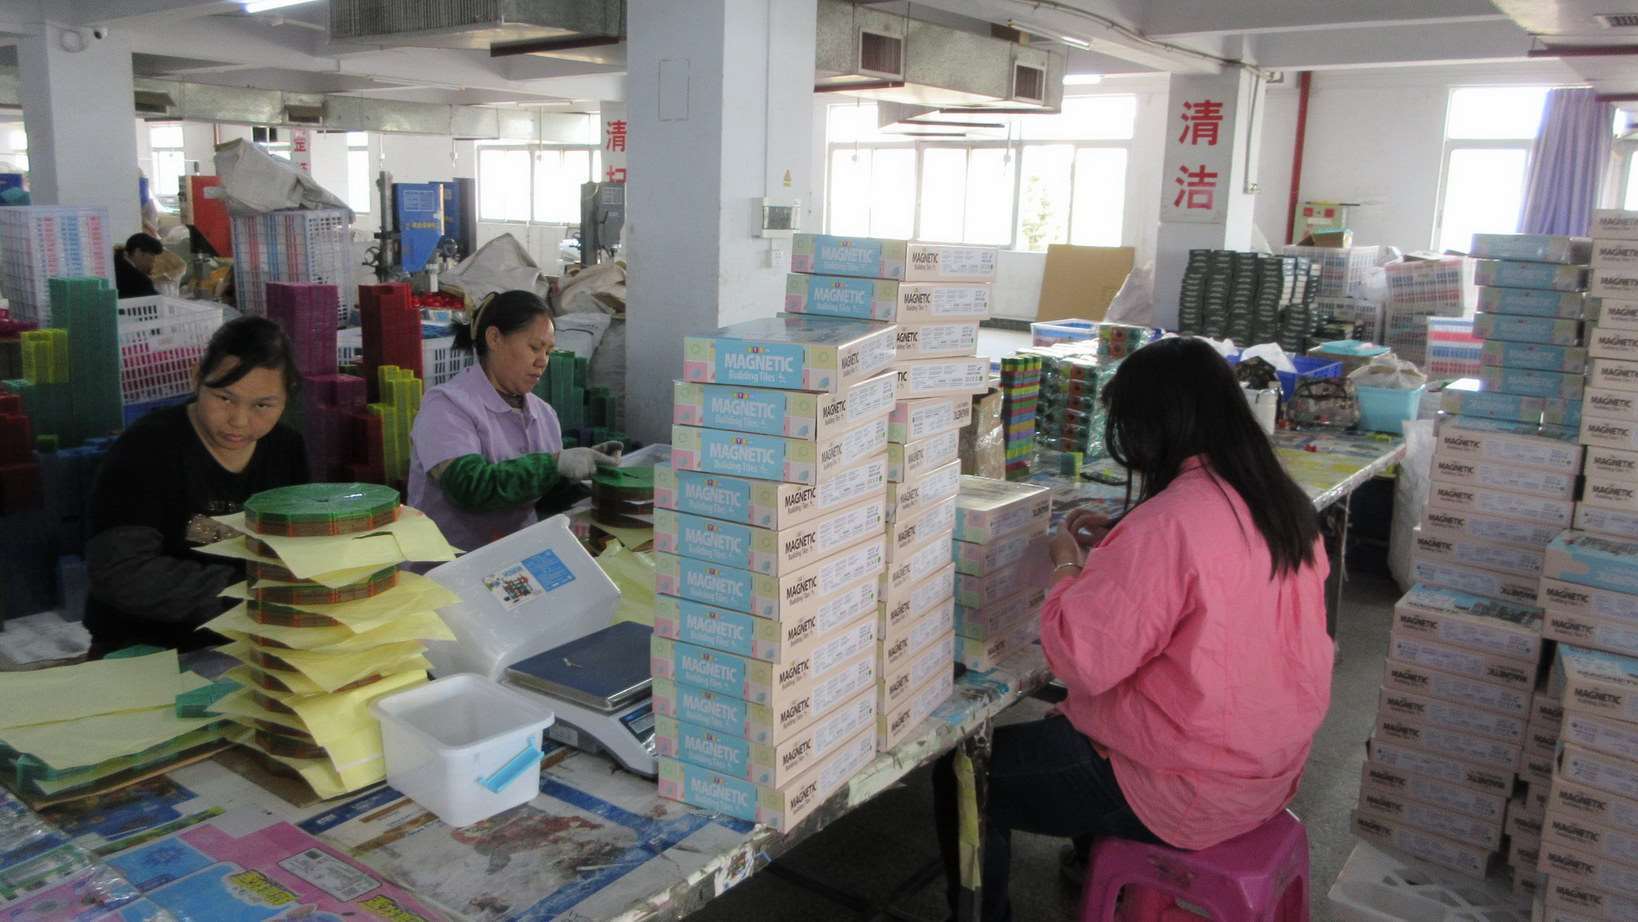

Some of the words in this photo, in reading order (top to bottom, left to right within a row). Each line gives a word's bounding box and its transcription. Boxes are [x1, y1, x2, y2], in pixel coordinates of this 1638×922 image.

[1174, 100, 1223, 210] 清洁
[821, 246, 873, 263] MAGNETIC
[912, 252, 938, 264] MAGNETIC
[814, 288, 865, 304] MAGNETIC
[904, 293, 931, 304] MAGNETIC
[897, 332, 918, 342] AGNETIC
[724, 352, 793, 372] MAGNETIC
[711, 398, 776, 418] MAGNETIC
[823, 399, 847, 419] MAGNETIC
[1591, 396, 1631, 408] MAGNETIC
[1588, 424, 1629, 436] MAGNETIC
[1444, 437, 1480, 449] MAGNETIC
[710, 443, 775, 464] MAGNETIC
[1594, 456, 1635, 469] MAGNETIC
[1439, 462, 1474, 474] MAGNETIC
[685, 483, 741, 506] MAGNETIC
[785, 487, 816, 508] MAGNETIC
[1437, 488, 1473, 501] MAGNETIC
[1593, 485, 1633, 497] MAGNETIC
[1428, 514, 1464, 526] MAGNETIC
[685, 528, 742, 552] MAGNETIC
[785, 532, 816, 554] MAGNETIC
[1417, 537, 1453, 551] MAGNETIC
[687, 570, 743, 597] MAGNETIC
[786, 576, 817, 600] MAGNETIC
[1546, 588, 1589, 603] MAGNETIC
[687, 614, 744, 640] MAGNETIC
[788, 616, 816, 641] MAGNETIC
[1401, 615, 1438, 630] MAGNETIC
[1552, 619, 1594, 635] MAGNETIC
[682, 655, 736, 682] MAGNETIC
[779, 658, 809, 684] MAGNETIC
[1391, 670, 1428, 684] MAGNETIC
[1387, 697, 1424, 712] MAGNETIC
[1575, 687, 1622, 705] MAGNETIC
[683, 693, 736, 721] MAGNETIC
[780, 697, 810, 724] MAGNETIC
[1383, 722, 1420, 738] MAGNETIC
[685, 735, 742, 764] MAGNETIC
[783, 738, 811, 766] MAGNETIC
[691, 778, 748, 806] MAGNETIC
[790, 780, 816, 810] MAGNETIC
[1560, 791, 1607, 810] MAGNETIC
[1553, 821, 1600, 842] MAGNETIC
[1548, 853, 1595, 874] MAGNETIC
